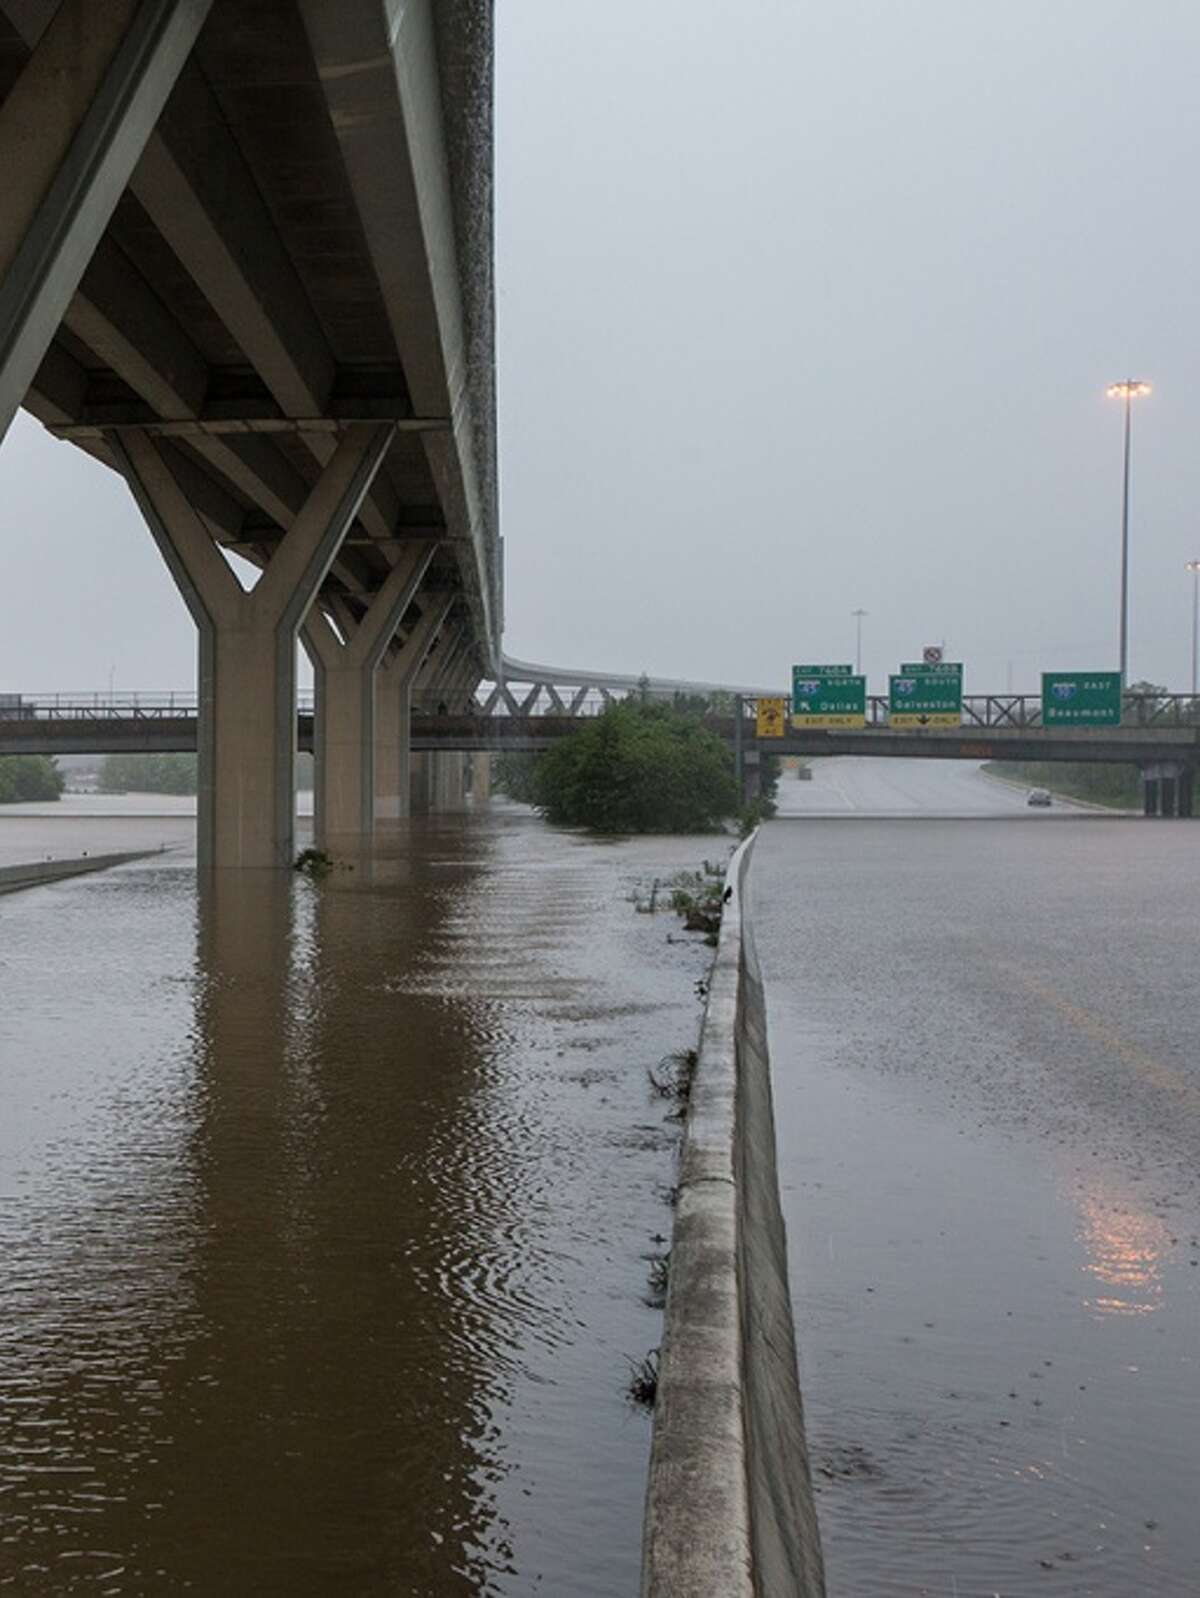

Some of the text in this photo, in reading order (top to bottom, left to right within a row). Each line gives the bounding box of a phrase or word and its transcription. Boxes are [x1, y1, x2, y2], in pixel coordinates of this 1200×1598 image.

[1083, 681, 1111, 690] EAST
[820, 701, 859, 711] Dallas
[895, 700, 957, 709] Galveston
[1048, 707, 1115, 718] Beaumont
[804, 716, 853, 725] EXIT ONLY
[893, 716, 959, 725] EXIT ONLY
